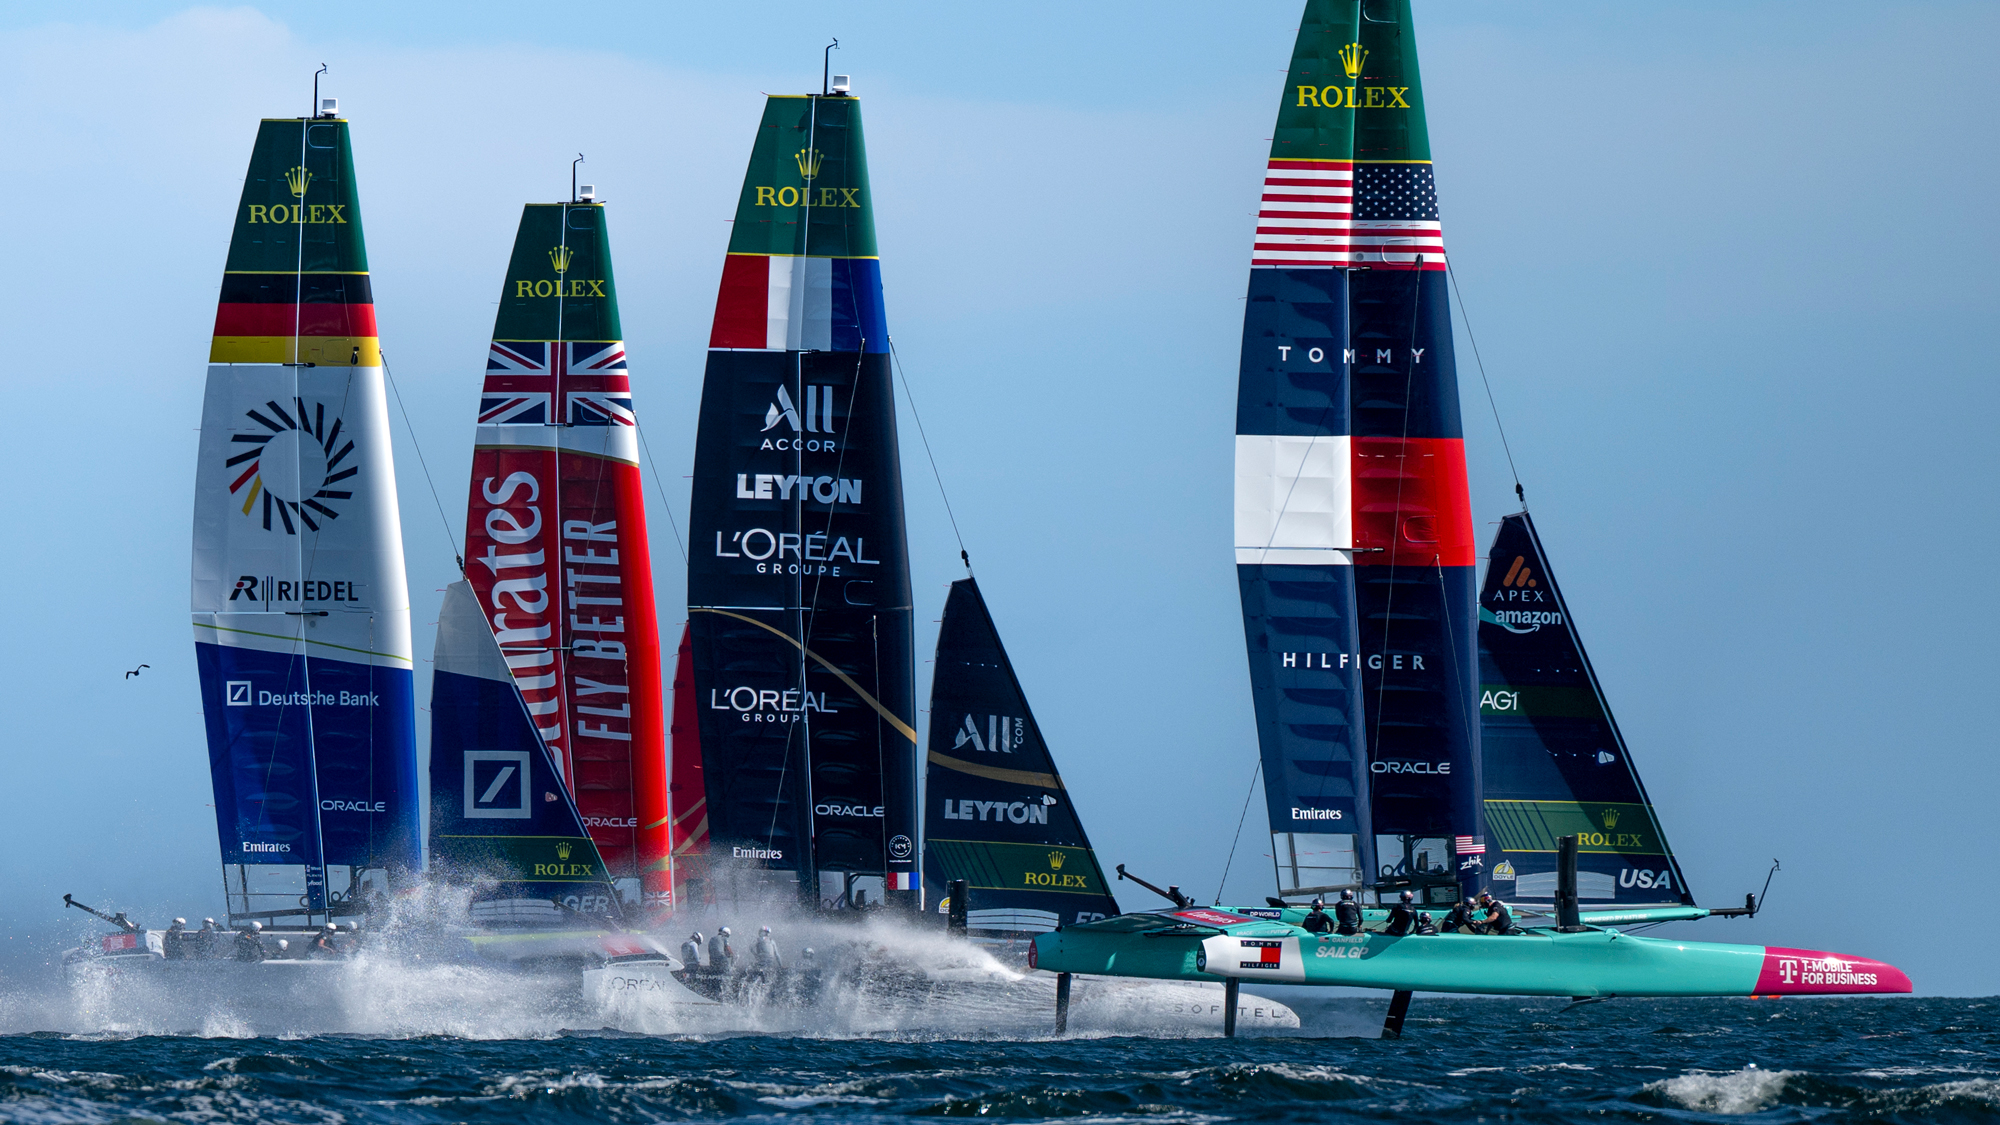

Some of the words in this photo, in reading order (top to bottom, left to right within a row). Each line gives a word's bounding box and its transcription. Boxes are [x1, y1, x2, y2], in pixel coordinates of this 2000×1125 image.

[1296, 85, 1411, 108] ROLEX
[755, 186, 861, 208] ROLEX
[248, 204, 347, 224] ROLEX
[515, 279, 605, 298] ROLEX
[1278, 346, 1425, 364] TOMMY
[760, 438, 836, 453] ACCOR
[736, 473, 862, 504] LEYTON
[716, 527, 880, 565] L'ORÉAL
[756, 563, 840, 577] GROUPE
[277, 580, 359, 602] RIEDEL
[563, 519, 627, 661] BETTER
[1493, 589, 1544, 602] APEX
[1494, 609, 1562, 625] amazon
[1282, 652, 1426, 671] HILFIGER
[258, 689, 335, 707] Deutsche
[339, 690, 379, 707] Bank
[711, 686, 838, 714] L'ORÉAL
[1480, 690, 1517, 711] AG1
[575, 676, 632, 741] FLY
[741, 713, 809, 724] GROUPE
[1371, 761, 1450, 775] ORACLE
[321, 800, 385, 813] ORACLE
[815, 804, 885, 818] ORACLE
[944, 799, 1048, 825] LEYTON
[1291, 807, 1342, 820] Emirates
[242, 841, 290, 853] Emirates
[1577, 832, 1643, 848] ROLEX
[732, 846, 783, 860] Emirates
[534, 863, 594, 877] ROLEX
[1460, 855, 1483, 870] zhik
[1024, 871, 1087, 889] ROLEX
[1619, 868, 1671, 890] USA
[563, 895, 610, 914] GER
[1075, 911, 1106, 925] FR
[1801, 959, 1853, 973] T-MOBILE
[1801, 973, 1824, 985] FOR
[1825, 973, 1878, 986] BUSINESS
[1174, 1003, 1281, 1019] SOFTEL
